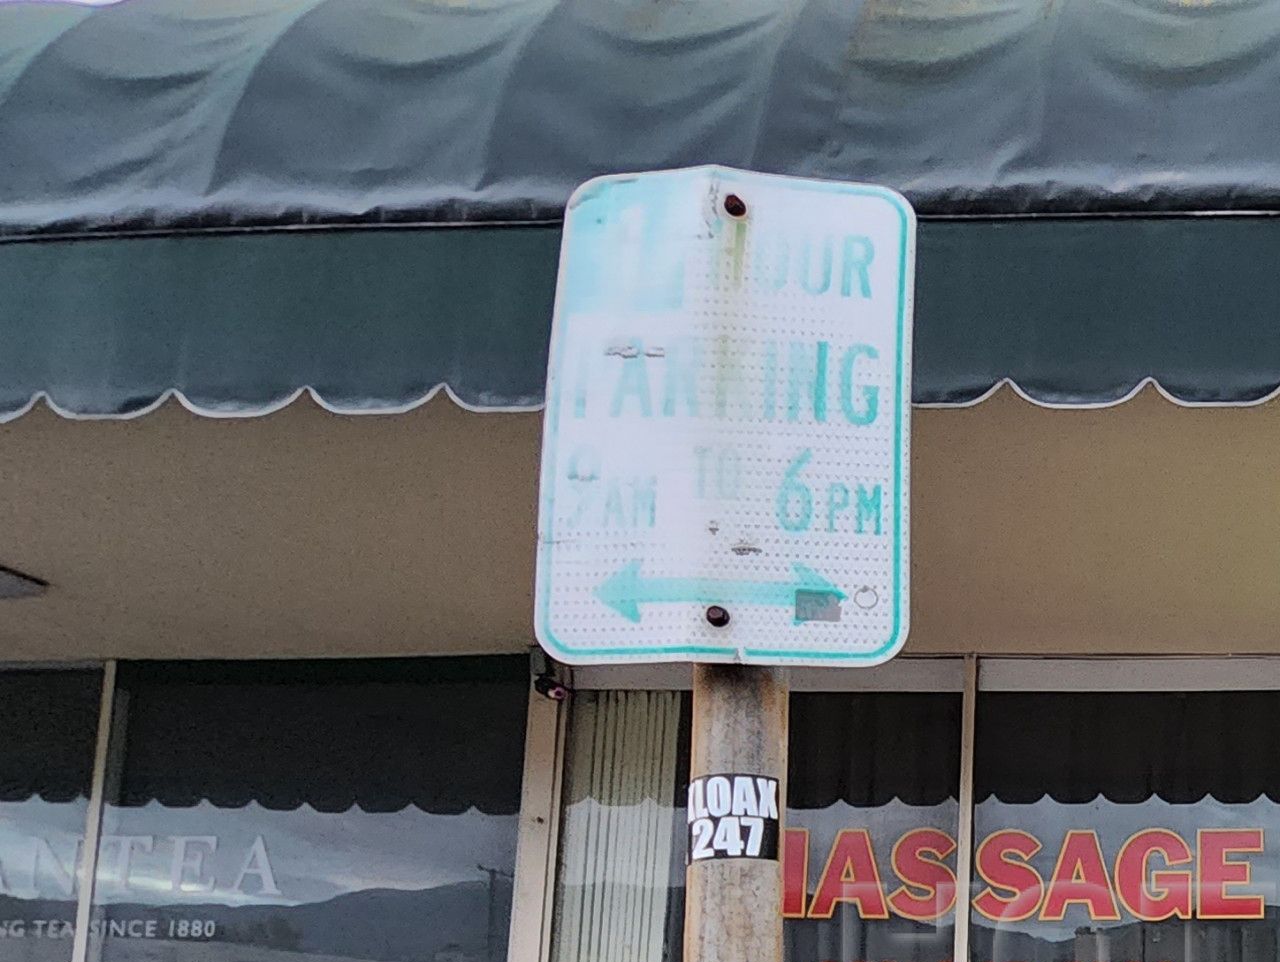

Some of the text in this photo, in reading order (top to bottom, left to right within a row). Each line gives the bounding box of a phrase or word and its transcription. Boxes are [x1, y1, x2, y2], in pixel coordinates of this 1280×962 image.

[573, 335, 880, 428] ARING
[691, 816, 764, 860] 247
[33, 920, 75, 939] TEA
[90, 919, 158, 938] SINCE
[168, 920, 216, 938] 1880
